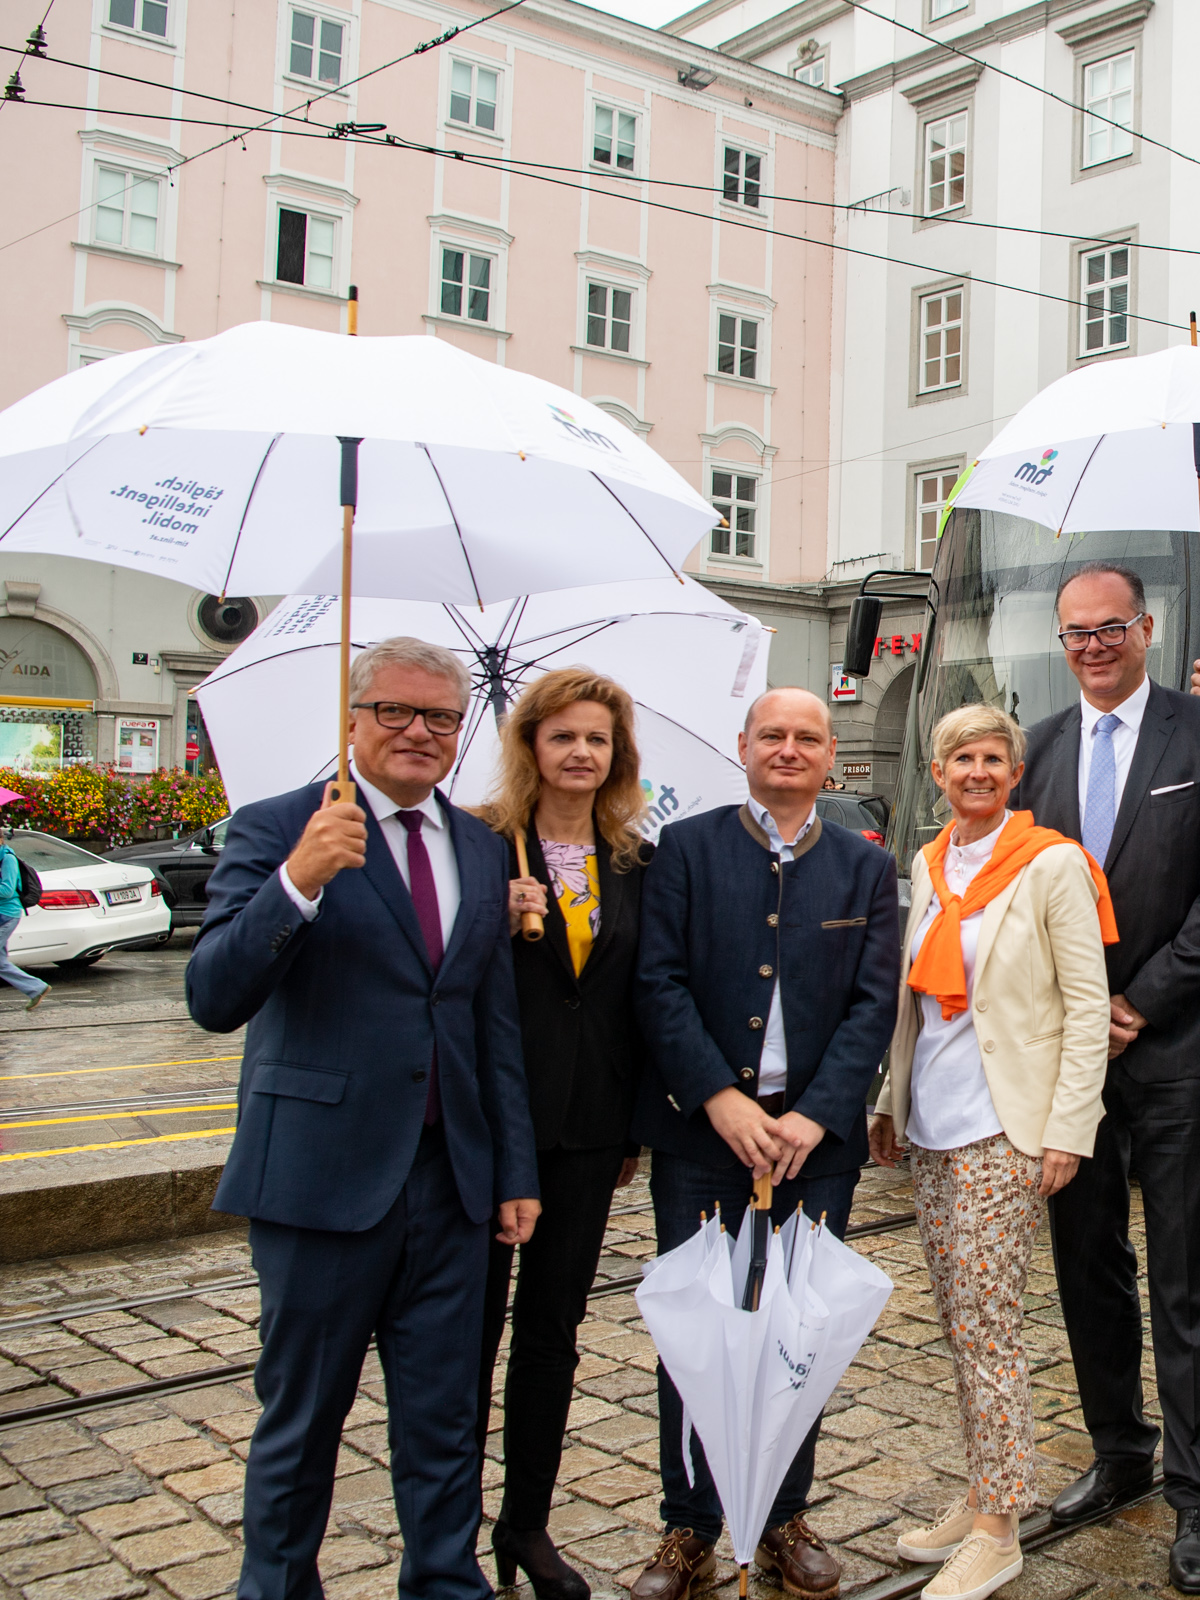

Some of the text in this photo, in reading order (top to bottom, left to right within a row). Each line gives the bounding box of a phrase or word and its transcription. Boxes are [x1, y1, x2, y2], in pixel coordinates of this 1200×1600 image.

[138, 653, 144, 661] 9
[12, 664, 51, 677] AIDA
[843, 764, 871, 774] FRISÖR
